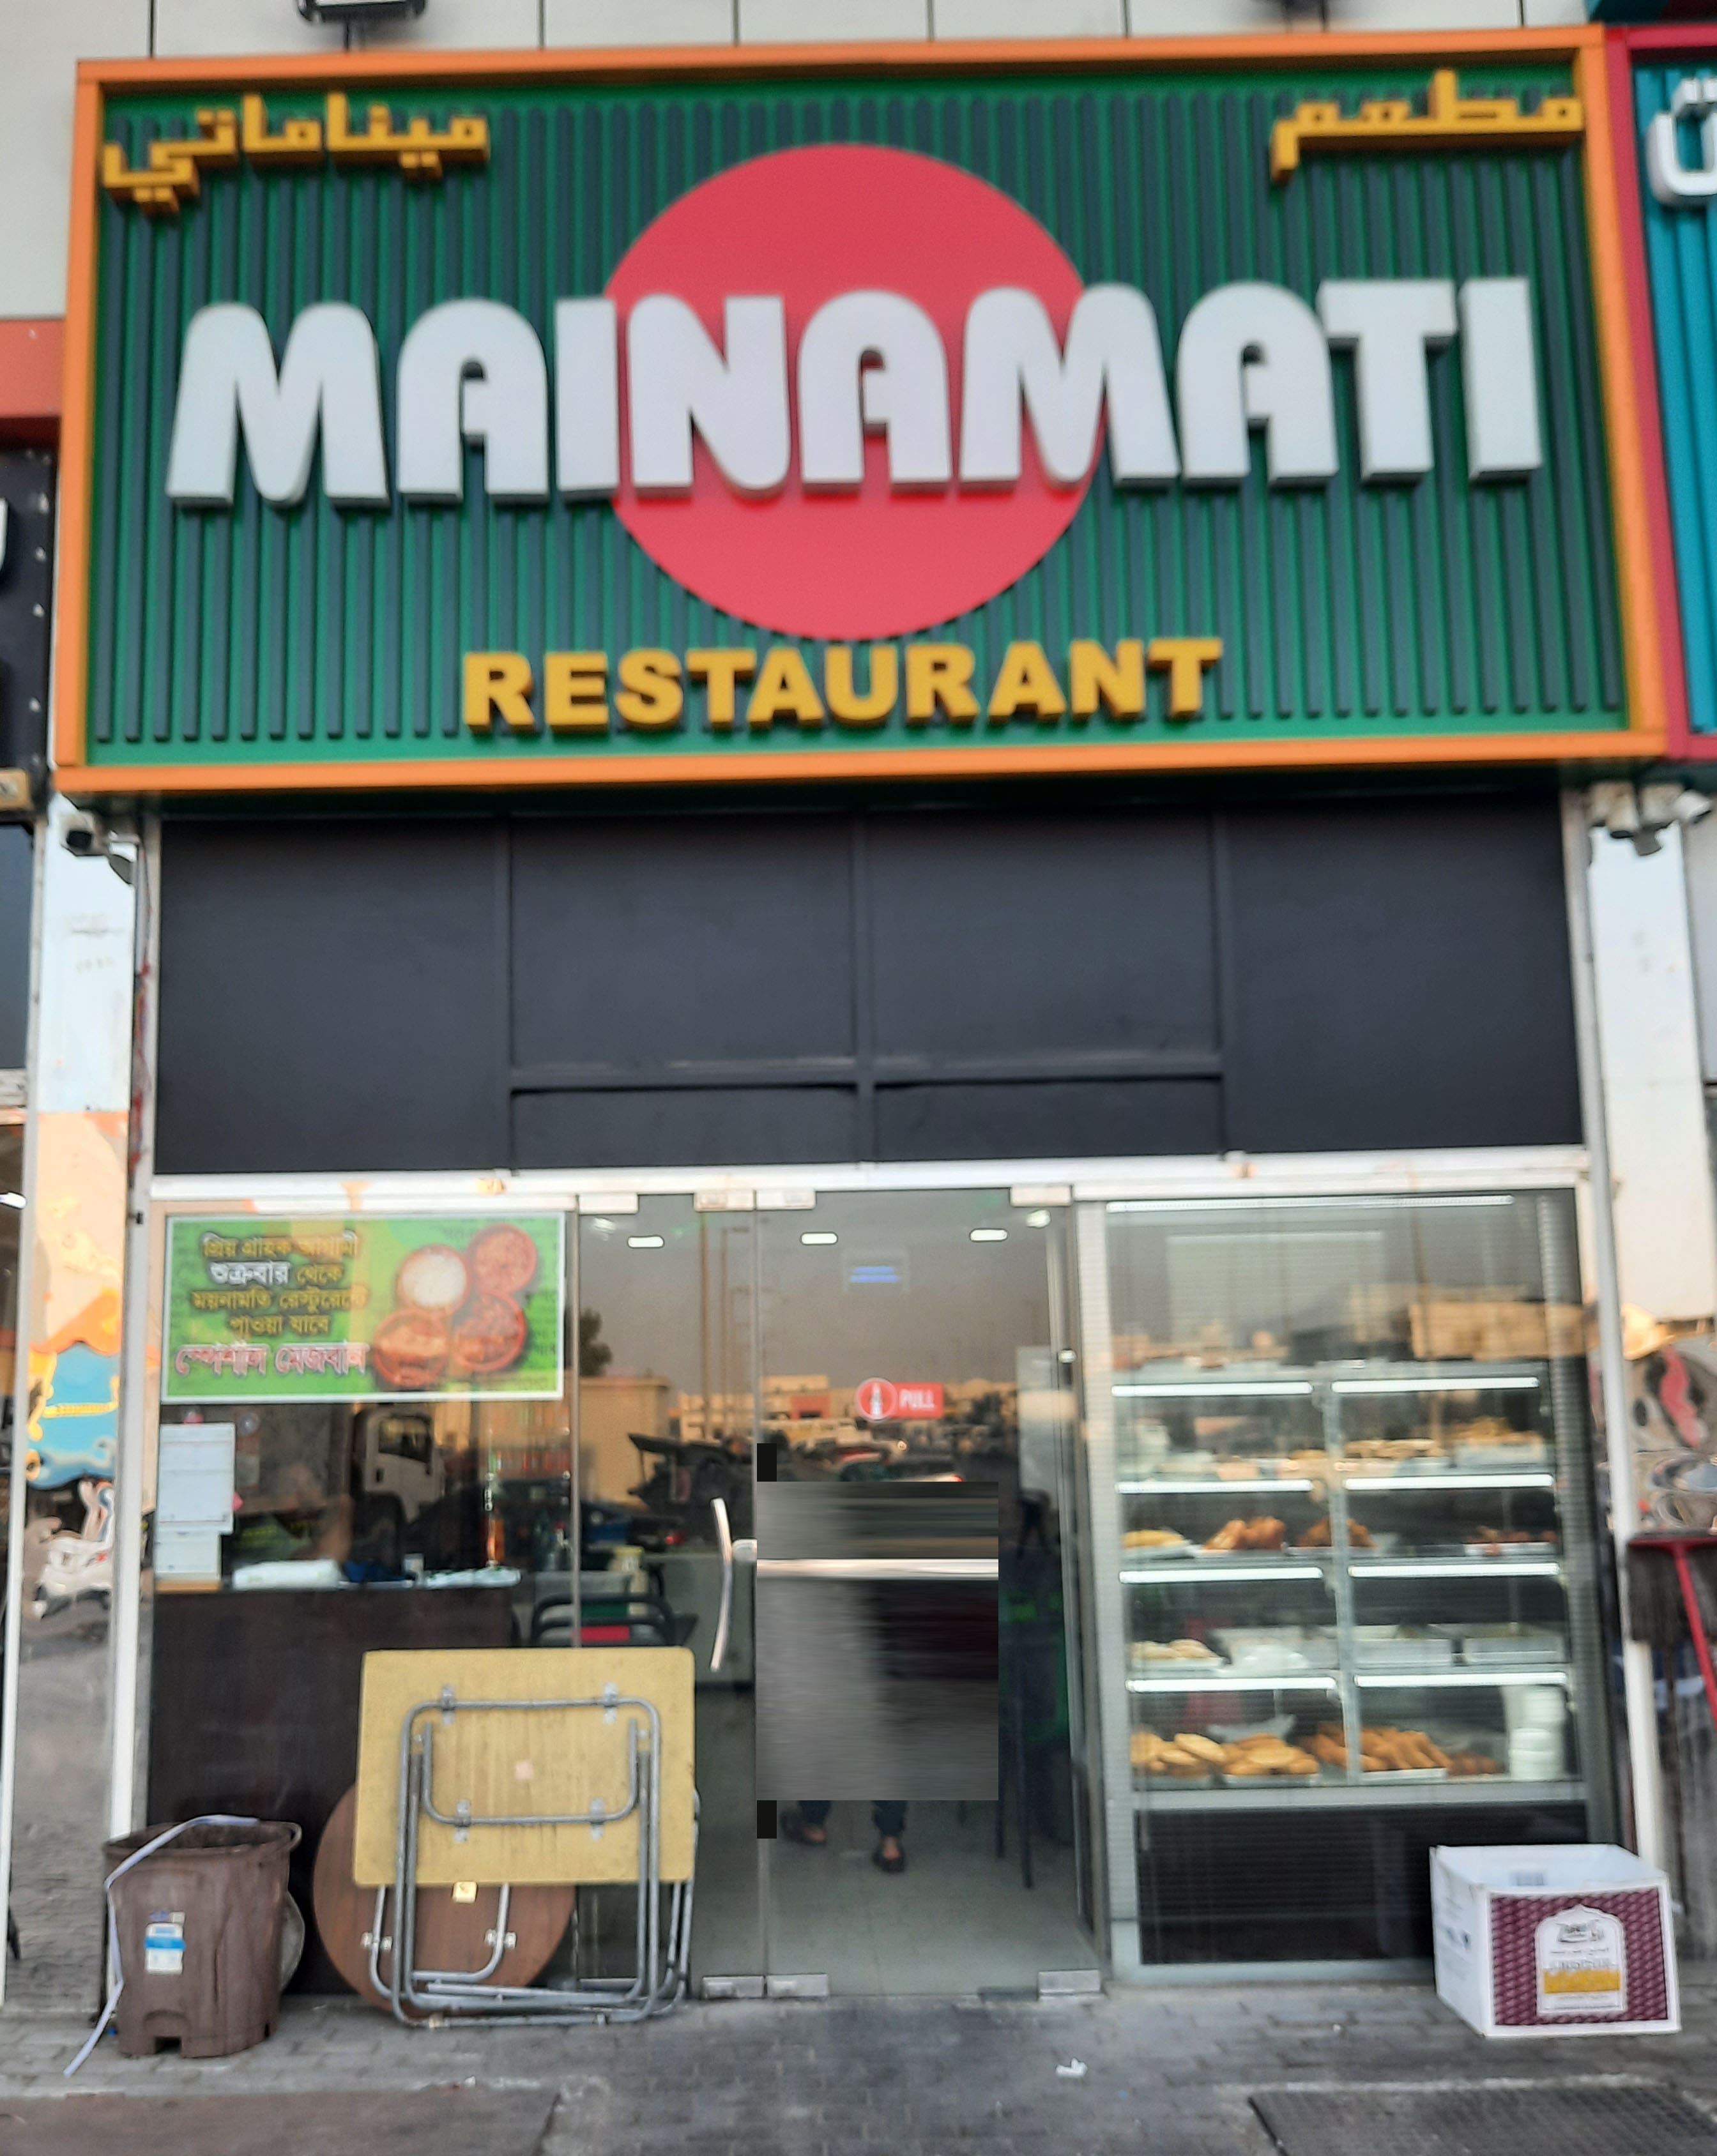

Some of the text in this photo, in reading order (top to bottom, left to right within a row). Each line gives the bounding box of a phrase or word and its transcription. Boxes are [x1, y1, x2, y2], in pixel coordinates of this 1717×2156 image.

[1271, 70, 1585, 179] مطعم
[102, 91, 491, 211] ميناماتي
[165, 276, 1541, 508] MAINAMATI
[462, 637, 1223, 734] RESTAURANT
[203, 1232, 238, 1257] প্রিয়
[241, 1237, 291, 1258] গ্রাহক
[210, 1261, 343, 1286] শুক্রবার থেকে
[192, 1285, 272, 1310] ময়নামতি
[229, 1314, 330, 1336] পাওয়া যাবে
[175, 1340, 370, 1376] স্পেশাল মেজবান
[899, 1390, 934, 1409] PULL
